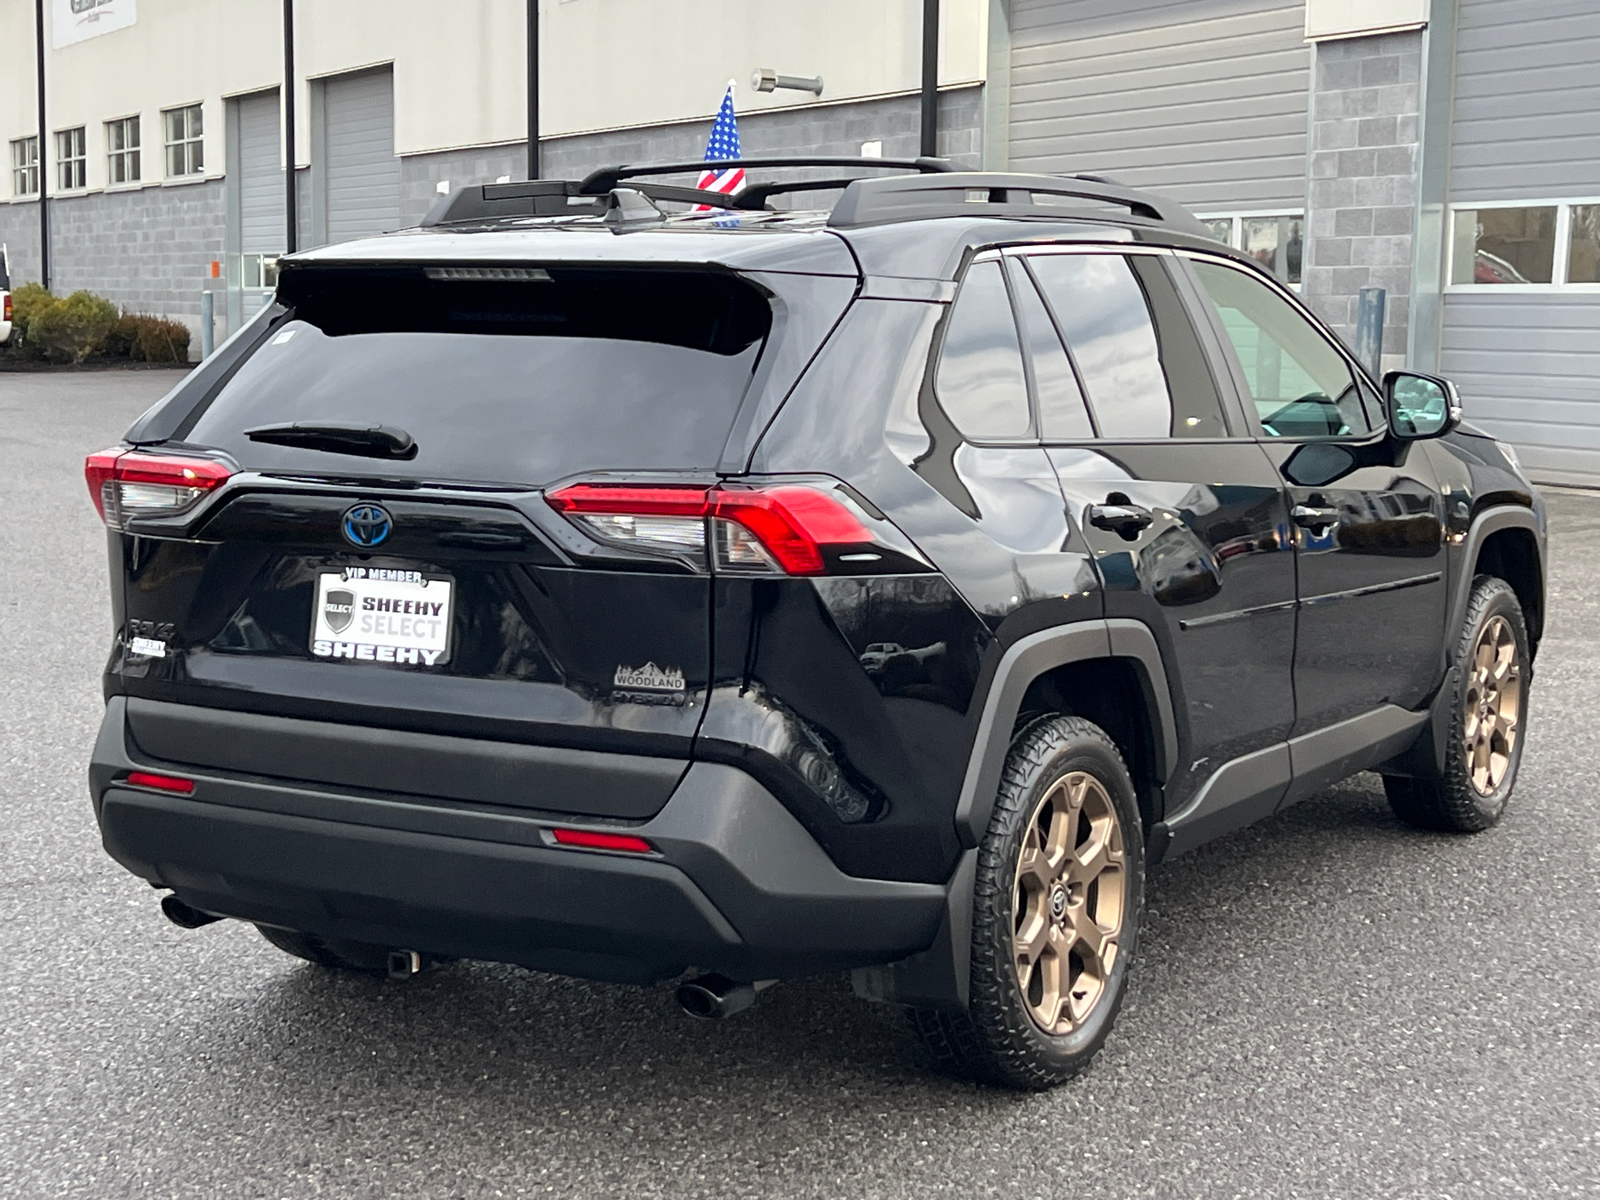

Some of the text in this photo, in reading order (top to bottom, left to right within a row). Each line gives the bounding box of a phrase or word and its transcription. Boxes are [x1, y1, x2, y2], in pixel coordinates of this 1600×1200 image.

[345, 567, 422, 583] VIP MEMBER
[325, 603, 353, 613] SELECT
[362, 596, 443, 617] SHEEHY
[361, 614, 442, 639] SELECT
[313, 640, 443, 666] SHEEHY
[616, 675, 683, 688] WOODLAND
